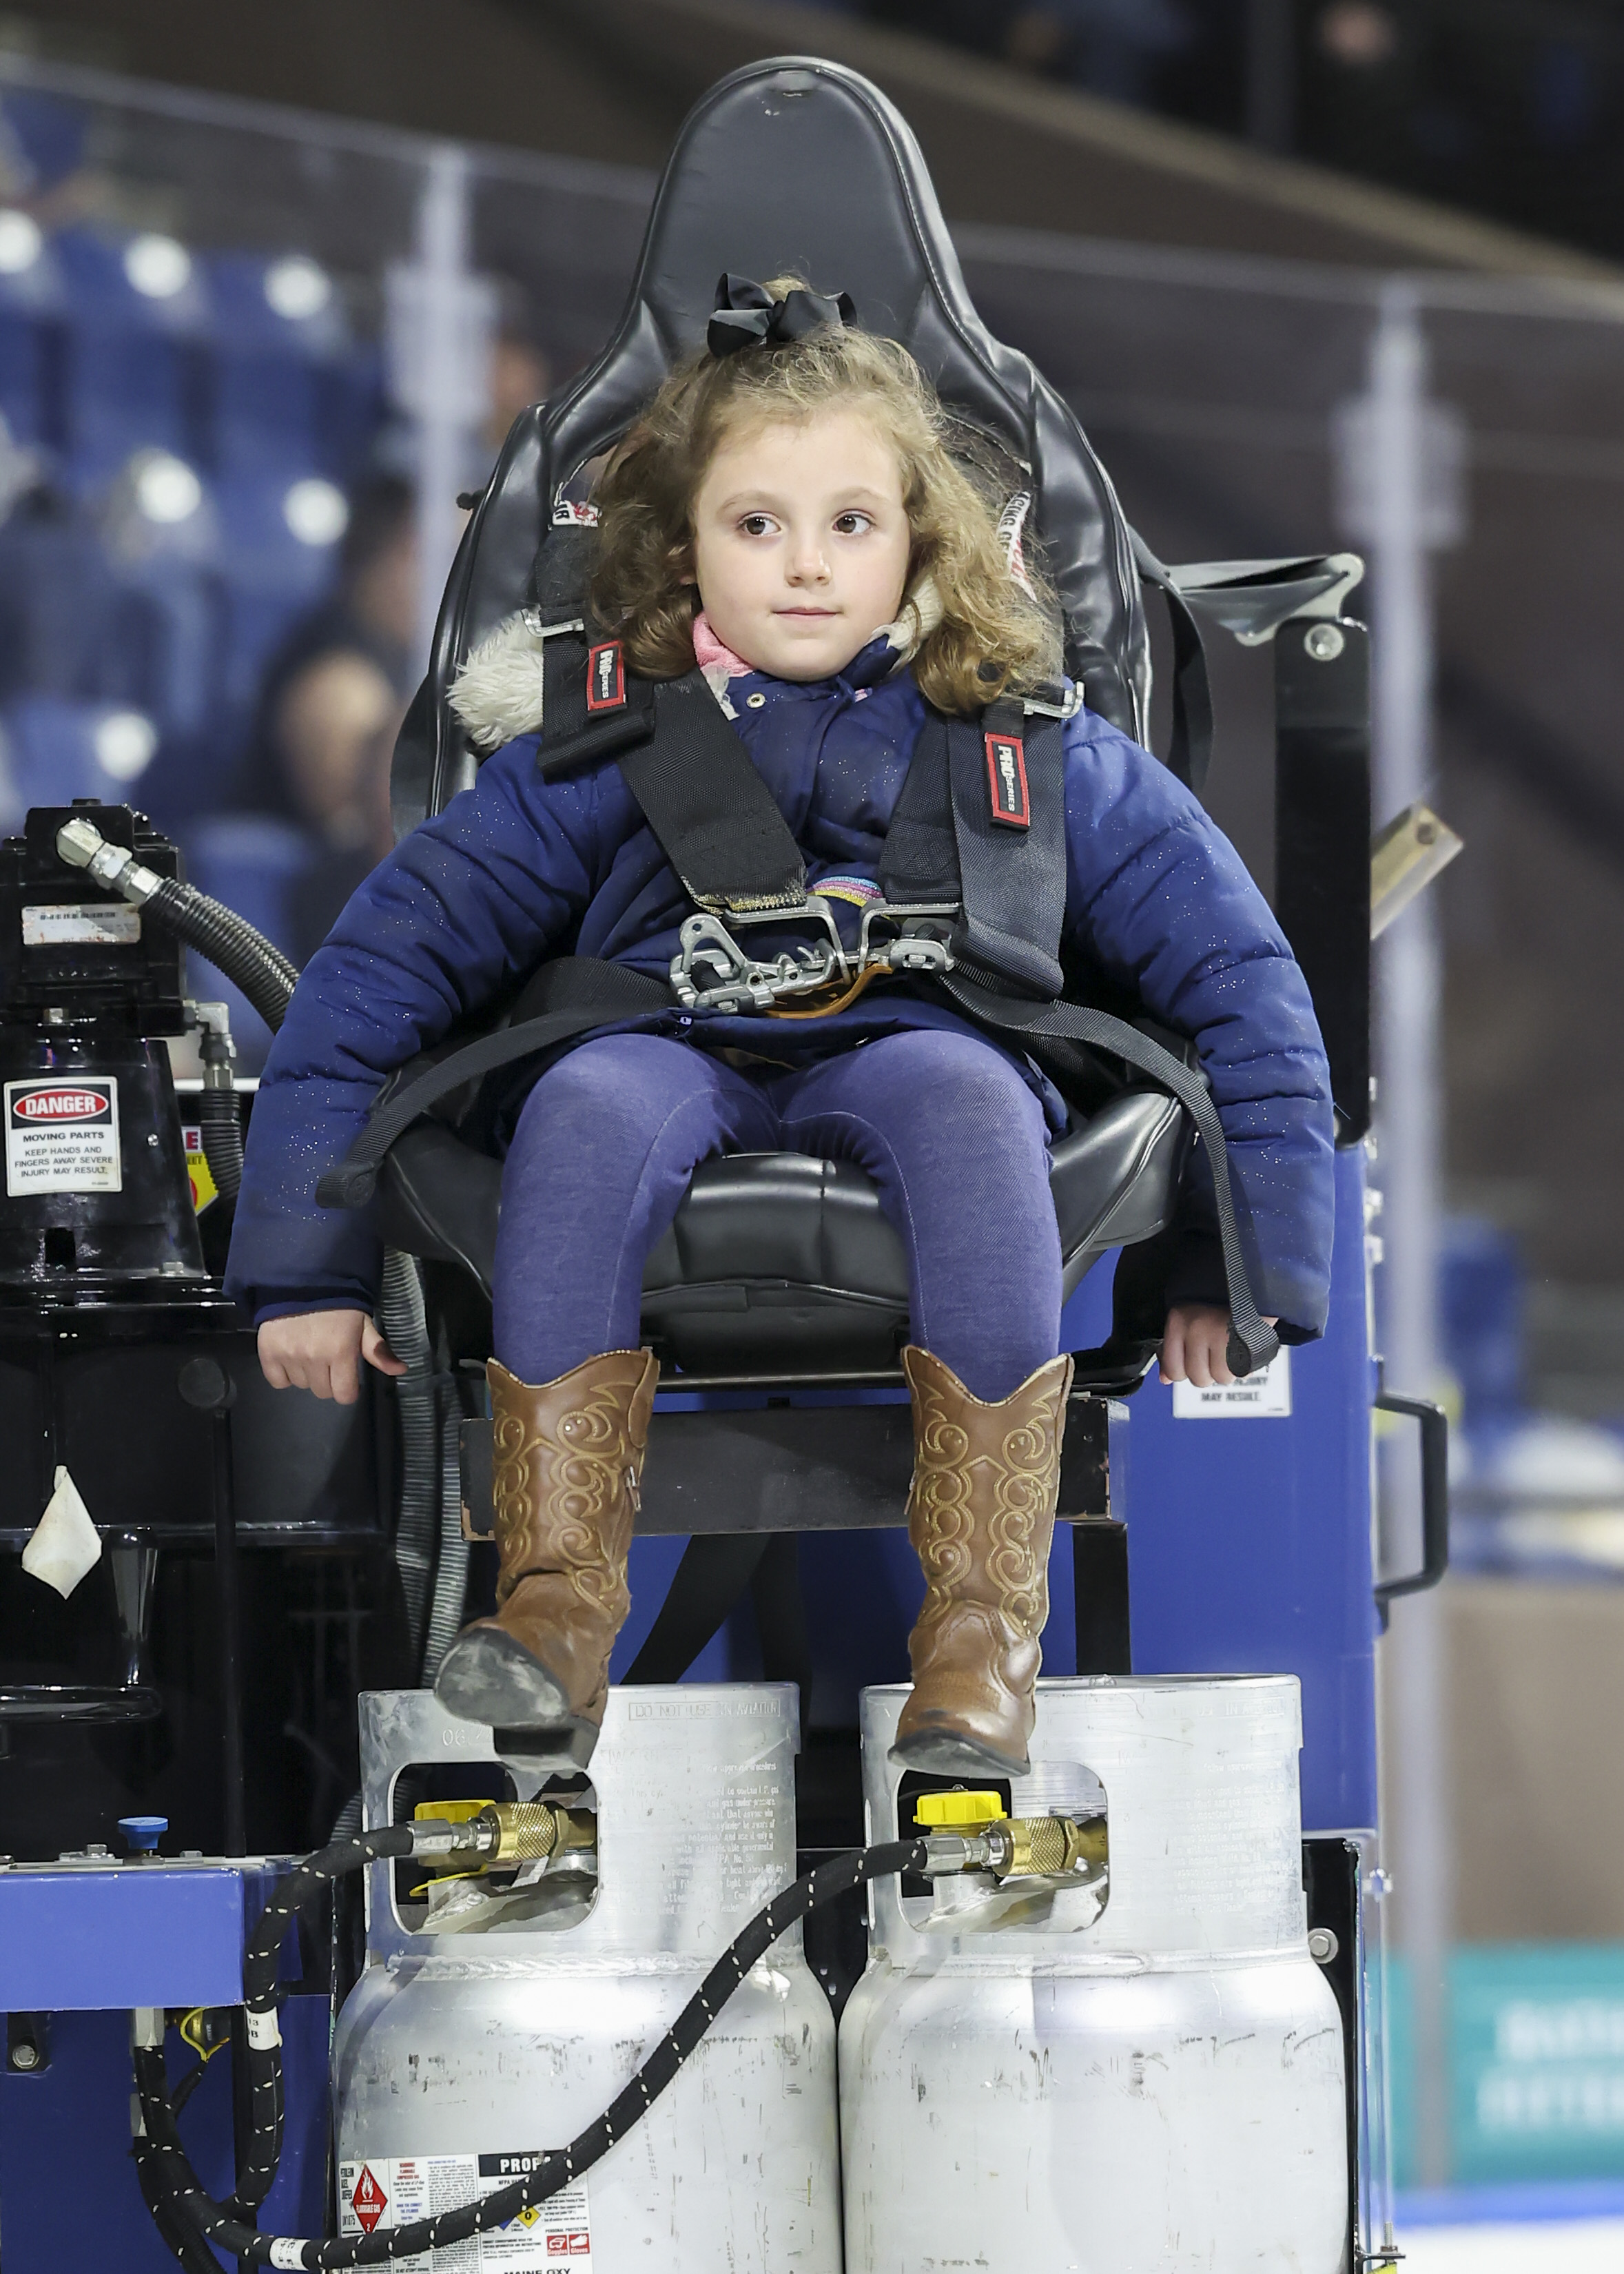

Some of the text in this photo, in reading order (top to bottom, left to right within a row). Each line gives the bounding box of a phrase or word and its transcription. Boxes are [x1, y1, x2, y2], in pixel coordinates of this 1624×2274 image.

[998, 745, 1016, 812] PRO SERIES
[25, 1096, 96, 1116] DANGER
[23, 1132, 66, 1143] MOVING
[14, 1158, 50, 1167] FINGERS
[21, 1169, 50, 1177] INJURY
[1201, 1392, 1222, 1402] MAY
[636, 1706, 652, 1717] DO
[659, 1705, 683, 1717] NOT
[525, 2211, 532, 2220] 0
[367, 2223, 371, 2232] 2
